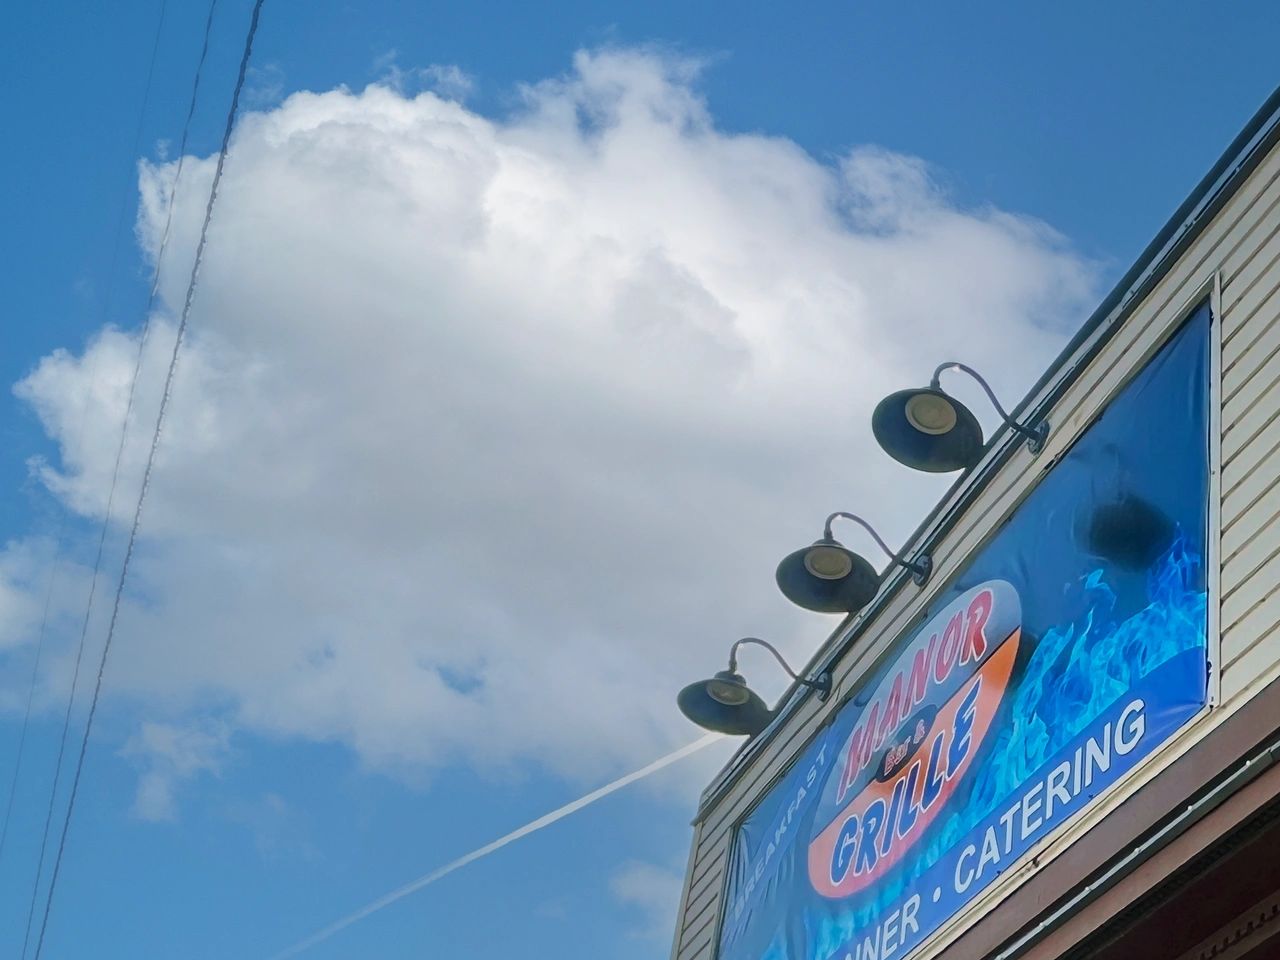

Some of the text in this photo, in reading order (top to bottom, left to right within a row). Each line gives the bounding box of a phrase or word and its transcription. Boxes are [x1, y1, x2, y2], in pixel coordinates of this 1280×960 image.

[828, 673, 984, 889] GRILLE
[836, 588, 995, 806] MANOR
[883, 735, 912, 777] Bar
[952, 697, 1148, 895] CATERING
